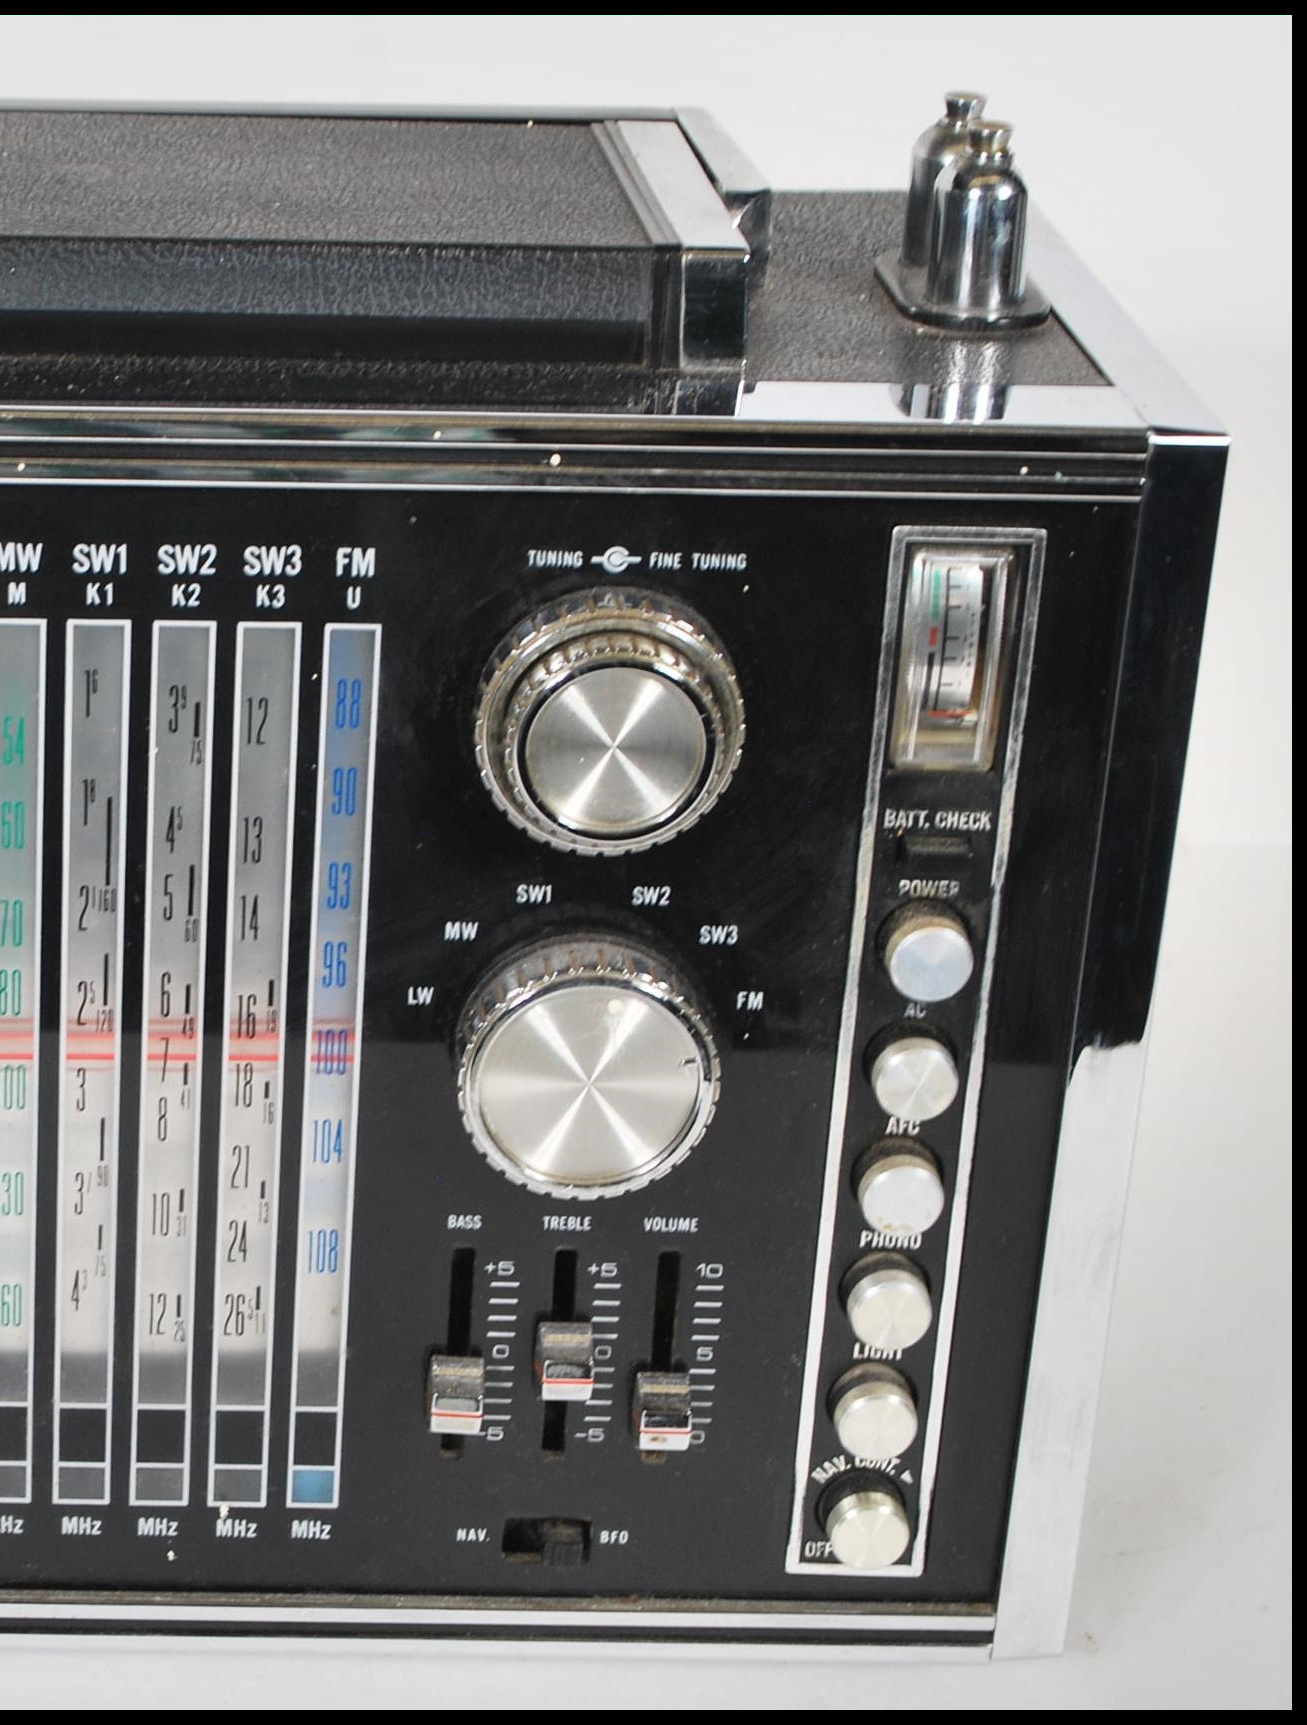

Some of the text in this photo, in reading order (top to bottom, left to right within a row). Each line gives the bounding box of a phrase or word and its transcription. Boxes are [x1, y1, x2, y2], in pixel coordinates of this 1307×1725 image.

[72, 543, 128, 574] SW1
[157, 544, 217, 575] SW2
[243, 545, 302, 577] SW3
[335, 547, 375, 578] FM
[527, 549, 584, 568] TUNING
[649, 551, 748, 571] FINE TUNING
[7, 583, 27, 605] M
[171, 584, 201, 607] K2
[256, 584, 286, 609] K3
[346, 586, 362, 610] U
[335, 679, 362, 729] 88
[246, 697, 269, 745] 12
[2, 715, 26, 766] 54
[331, 767, 358, 816] 90
[1, 801, 25, 849] 60
[882, 807, 992, 833] BATT. CHECK
[243, 816, 263, 864] 13
[163, 873, 174, 921] 5
[326, 862, 352, 910] 93
[516, 883, 553, 904] SW1
[631, 885, 672, 907] SW2
[898, 878, 961, 898] POWER
[0, 899, 24, 948] 70
[241, 894, 260, 941] 14
[444, 921, 479, 941] MW
[698, 924, 739, 946] SW3
[322, 941, 348, 989] 96
[160, 971, 172, 1018] 6
[407, 986, 435, 1006] LW
[736, 991, 764, 1010] FM
[903, 1000, 927, 1019] AC
[237, 993, 257, 1039] 16
[159, 1036, 170, 1083] 7
[316, 1028, 348, 1076] 100
[77, 1067, 86, 1112] 3
[235, 1062, 254, 1108] 18
[157, 1096, 168, 1142] 8
[885, 1116, 921, 1136] AFC
[313, 1119, 343, 1164] 104
[230, 1144, 251, 1189] 21
[152, 1192, 171, 1237] 10
[447, 1214, 483, 1230] BASS
[542, 1215, 592, 1232] TREBLE
[643, 1216, 699, 1234] VOLUME
[227, 1219, 248, 1263] 24
[308, 1229, 339, 1274] 108
[859, 1229, 922, 1250] PHONO
[484, 1260, 515, 1277] +5
[587, 1261, 619, 1279] +5
[695, 1262, 724, 1280] 10
[149, 1292, 167, 1336] 12
[491, 1344, 510, 1359] 0
[61, 1516, 102, 1536] MHz
[137, 1516, 178, 1537] MHz
[216, 1518, 258, 1539] MHz
[291, 1519, 331, 1541] MHz
[456, 1527, 491, 1543] NAV.
[599, 1529, 630, 1545] BFO
[804, 1540, 834, 1558] OFF
